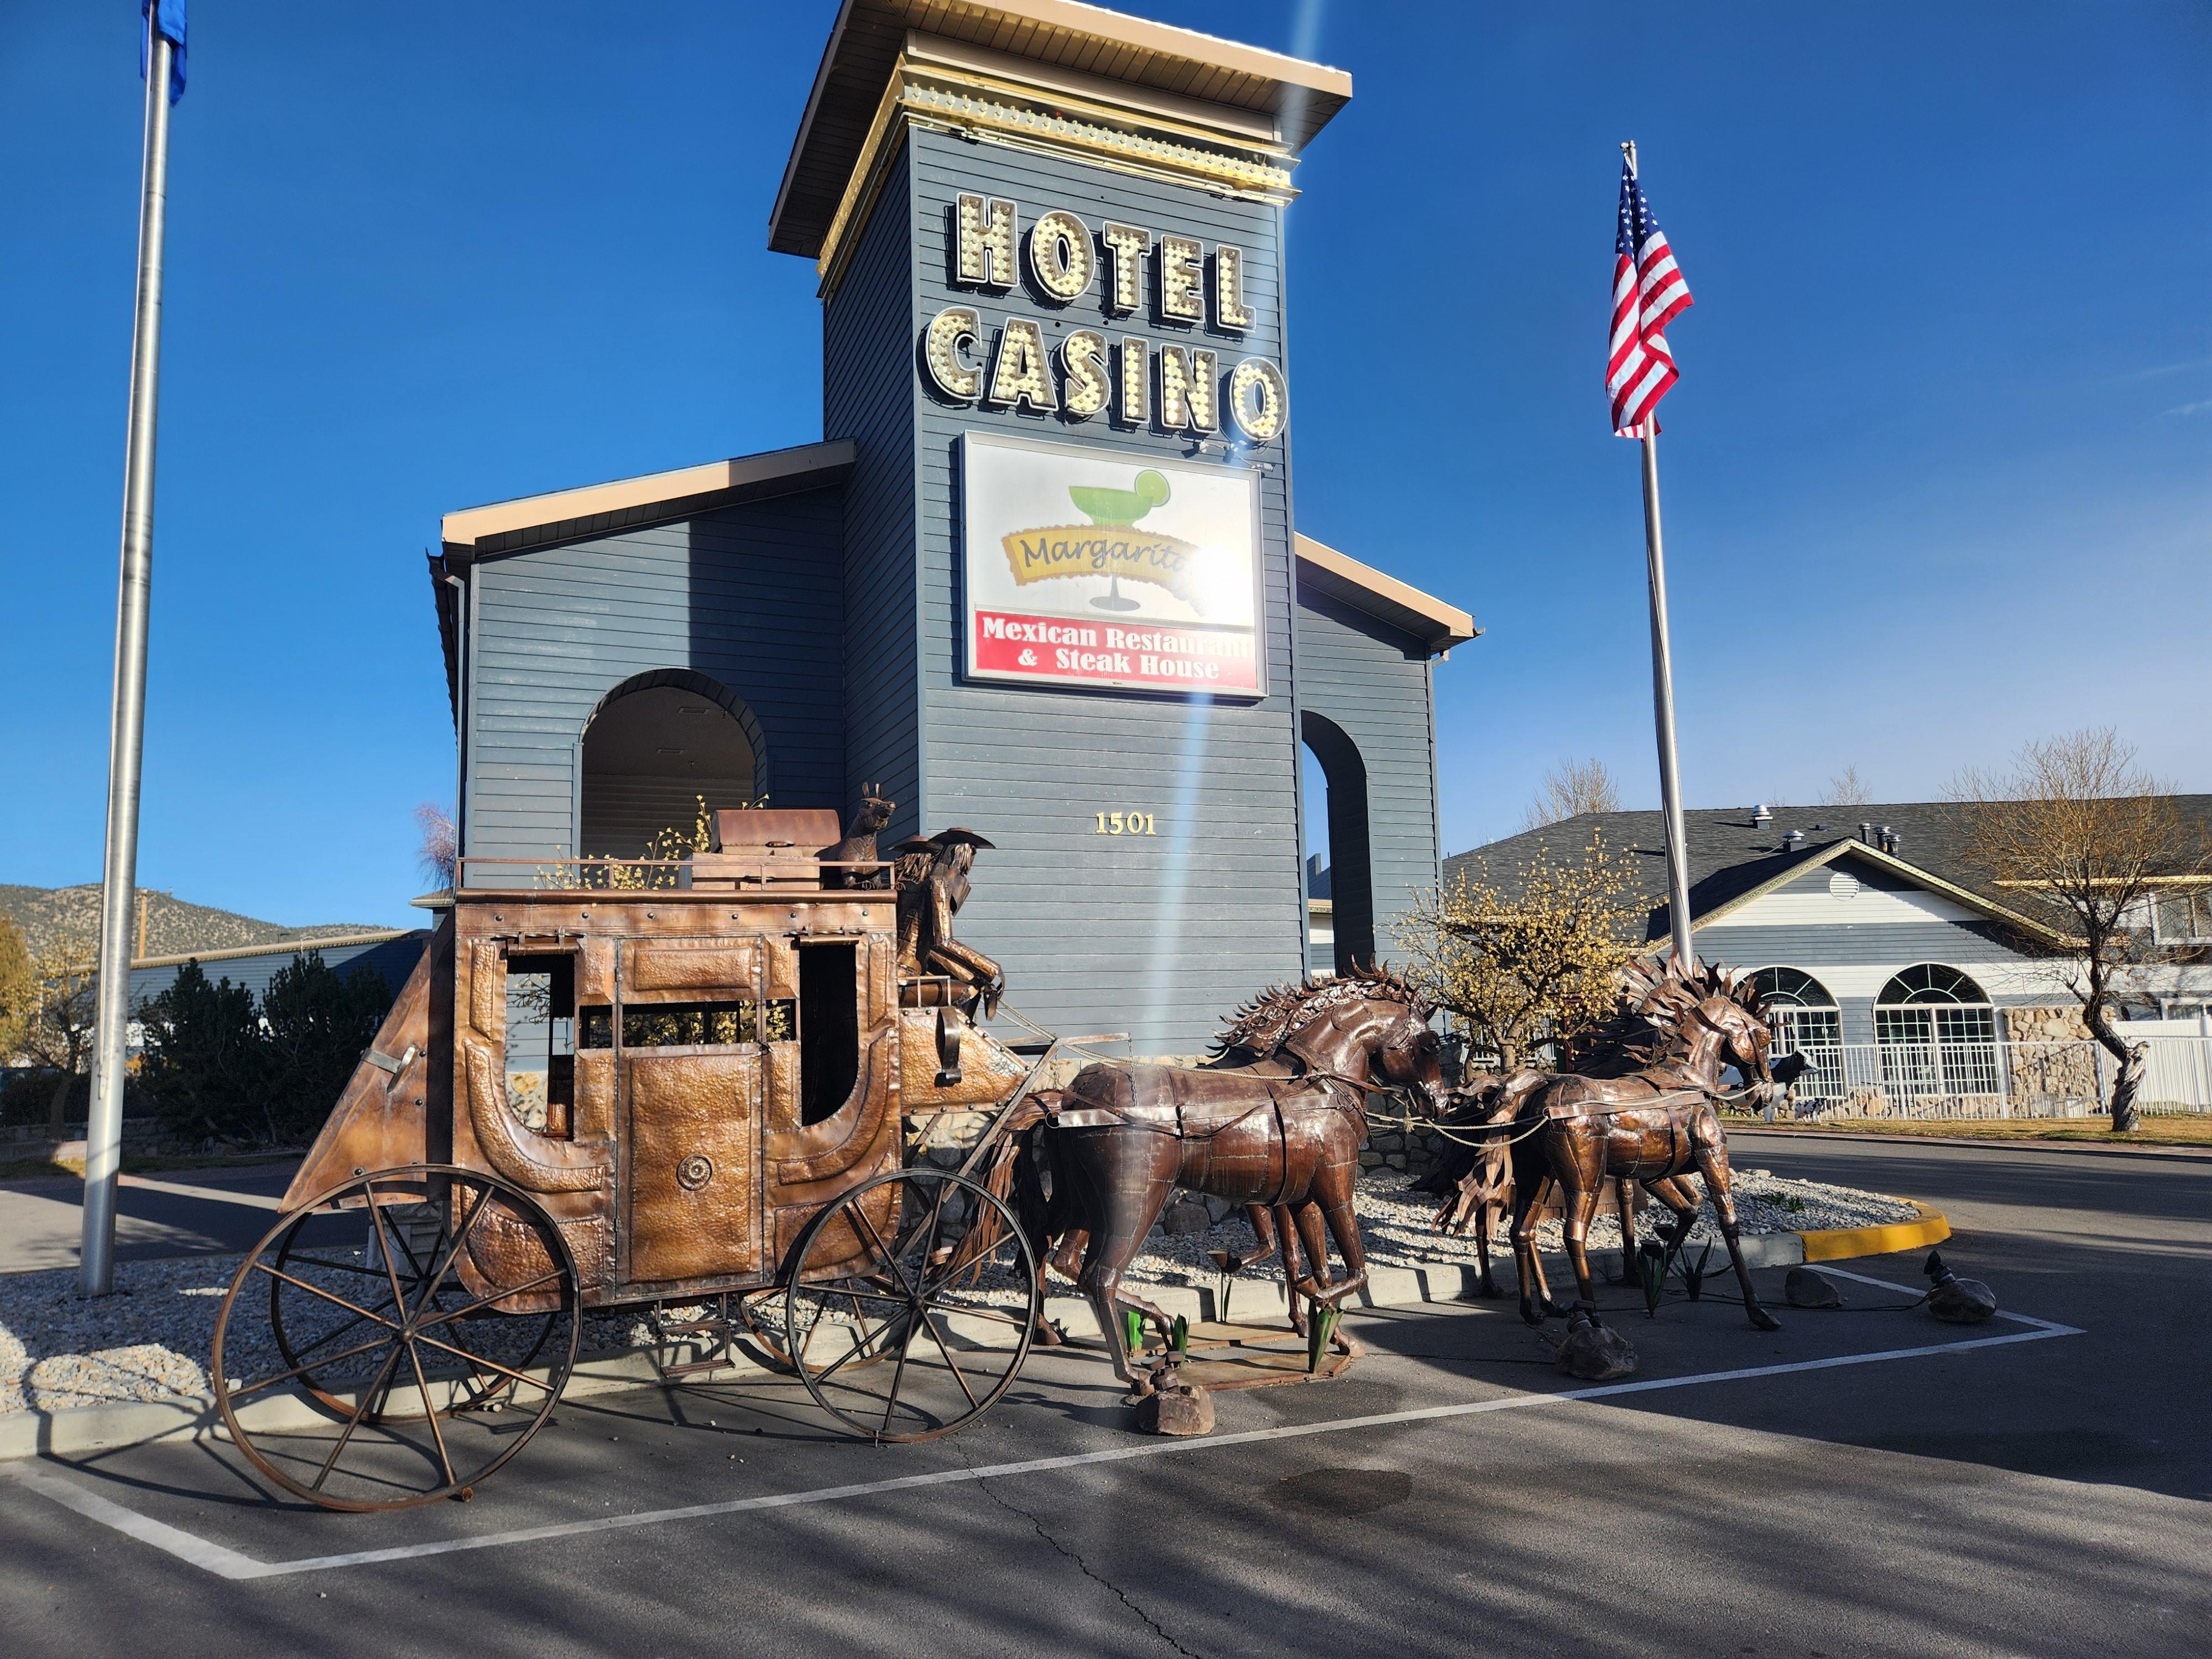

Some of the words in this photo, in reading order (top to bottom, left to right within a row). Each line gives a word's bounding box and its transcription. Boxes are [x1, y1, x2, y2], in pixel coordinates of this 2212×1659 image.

[957, 192, 1257, 332] HOTEL
[925, 306, 1288, 441] CASINO
[982, 617, 1097, 647] Mexican
[1105, 628, 1249, 659] Restaurant
[1018, 649, 1037, 666] &
[1056, 648, 1131, 675] Steak
[1140, 655, 1220, 680] House
[1096, 812, 1156, 835] 1501
